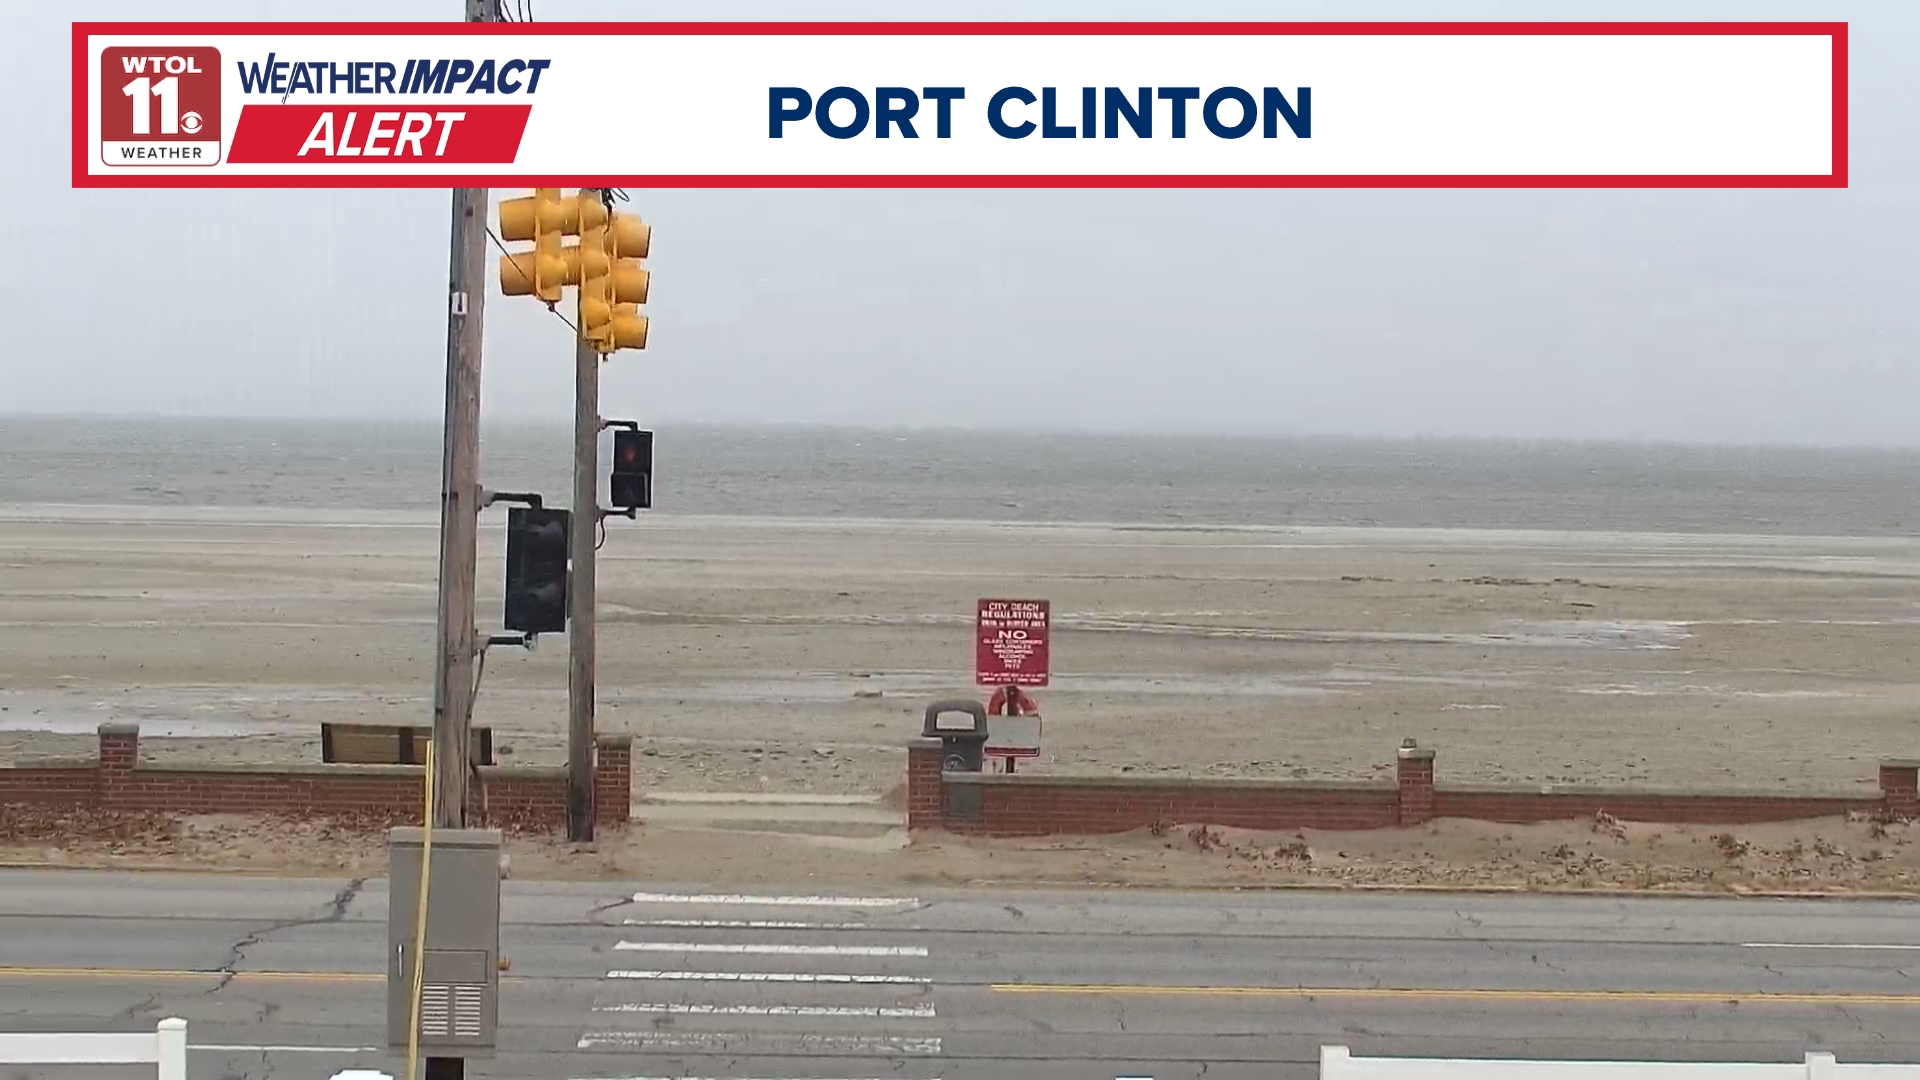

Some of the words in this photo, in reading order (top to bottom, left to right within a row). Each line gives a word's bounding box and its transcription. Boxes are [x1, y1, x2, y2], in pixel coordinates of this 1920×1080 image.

[989, 602, 1008, 611] CITY
[1011, 603, 1039, 612] BEACH
[981, 610, 1045, 619] REGULATIONS
[998, 630, 1027, 639] NO
